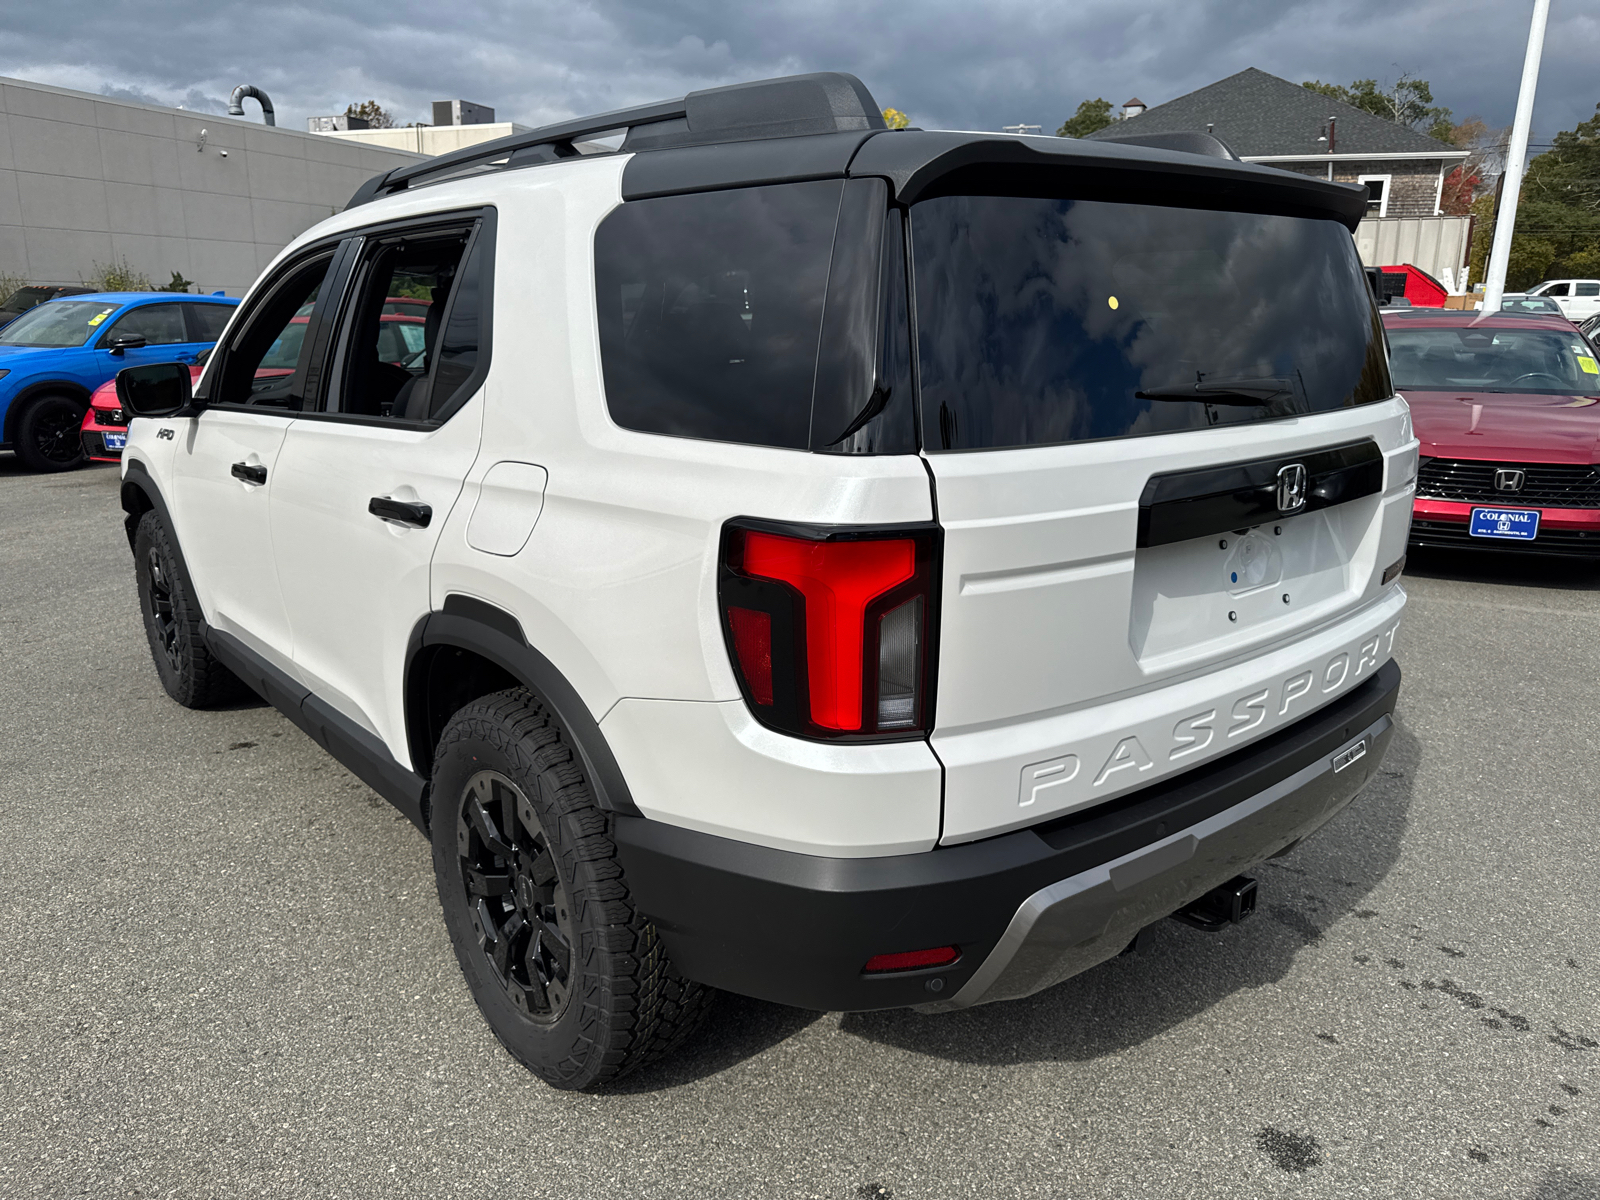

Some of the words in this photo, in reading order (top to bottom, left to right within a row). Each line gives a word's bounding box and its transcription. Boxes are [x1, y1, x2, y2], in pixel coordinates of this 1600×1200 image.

[156, 427, 175, 441] HPD
[1480, 512, 1531, 522] COLONIAL
[1018, 620, 1400, 808] PASSPORT
